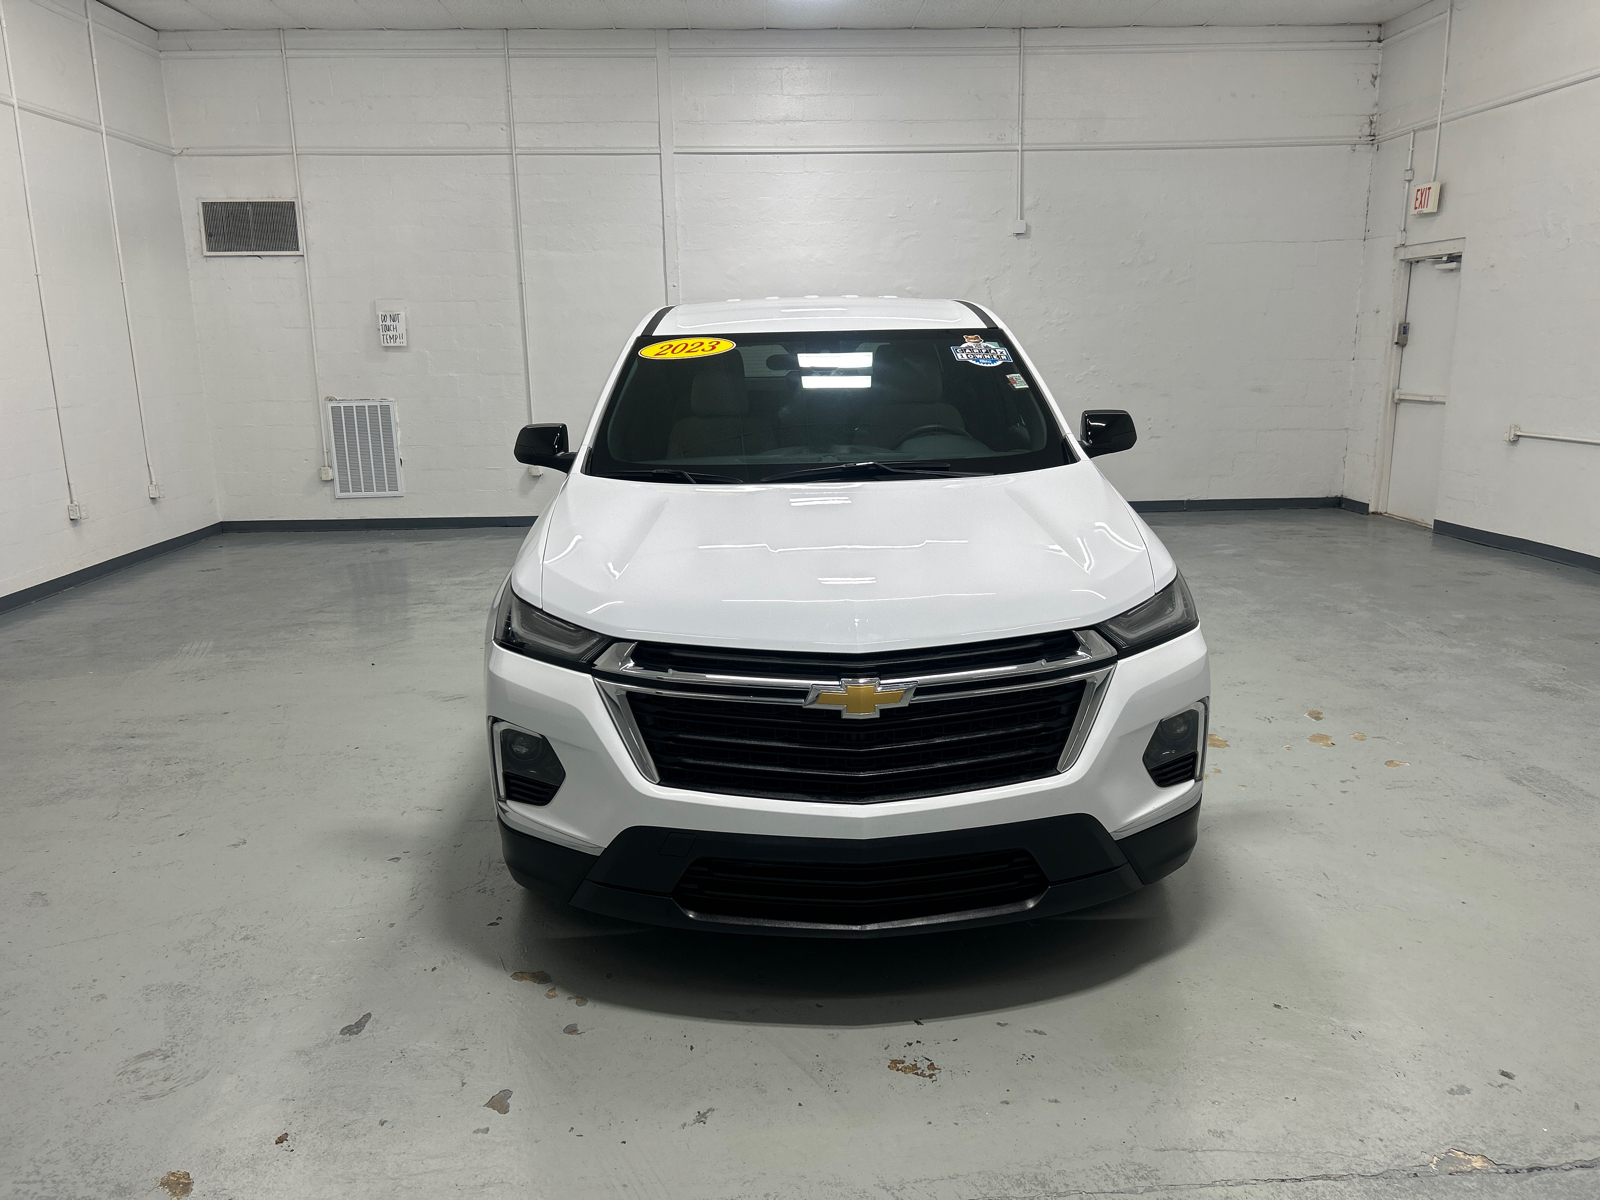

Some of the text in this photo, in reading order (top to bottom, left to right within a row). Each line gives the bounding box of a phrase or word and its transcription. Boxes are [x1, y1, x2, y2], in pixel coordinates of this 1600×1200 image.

[1414, 187, 1431, 210] EXIT
[381, 313, 400, 323] DO NOT
[381, 324, 397, 333] TOUCH
[382, 333, 403, 344] TEMP!!
[653, 341, 720, 356] 2023
